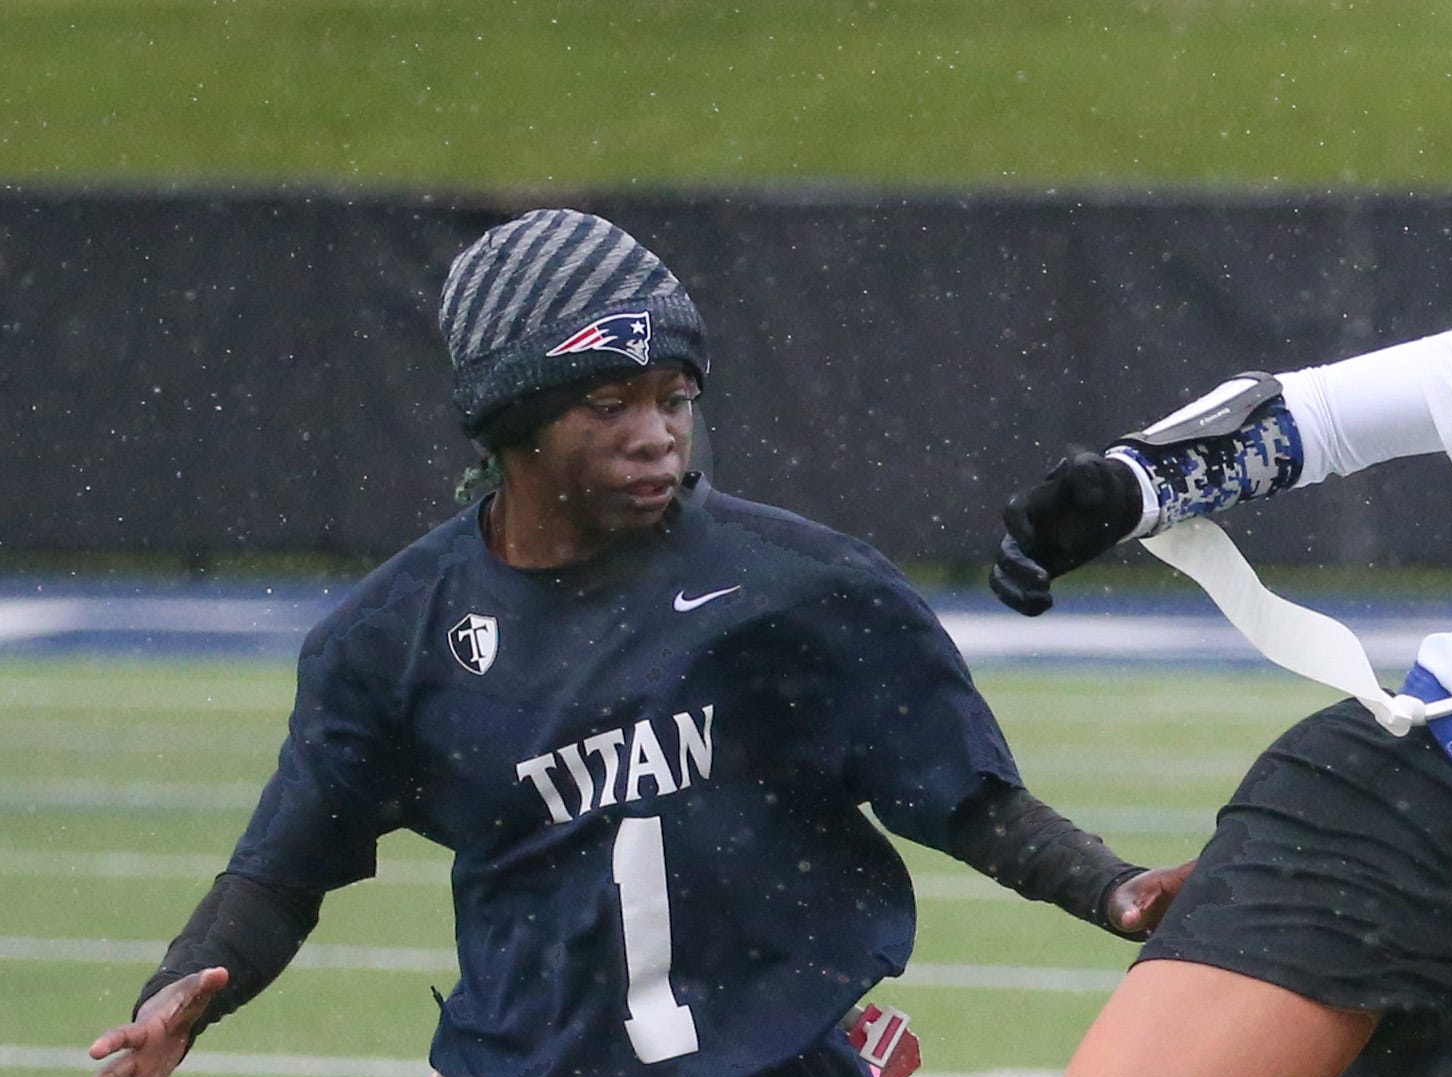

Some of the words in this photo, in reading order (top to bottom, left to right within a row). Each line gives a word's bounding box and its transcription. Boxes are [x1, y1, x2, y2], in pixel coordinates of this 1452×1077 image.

[457, 626, 493, 663] T
[515, 703, 715, 825] TITAN
[612, 814, 699, 1064] 1
